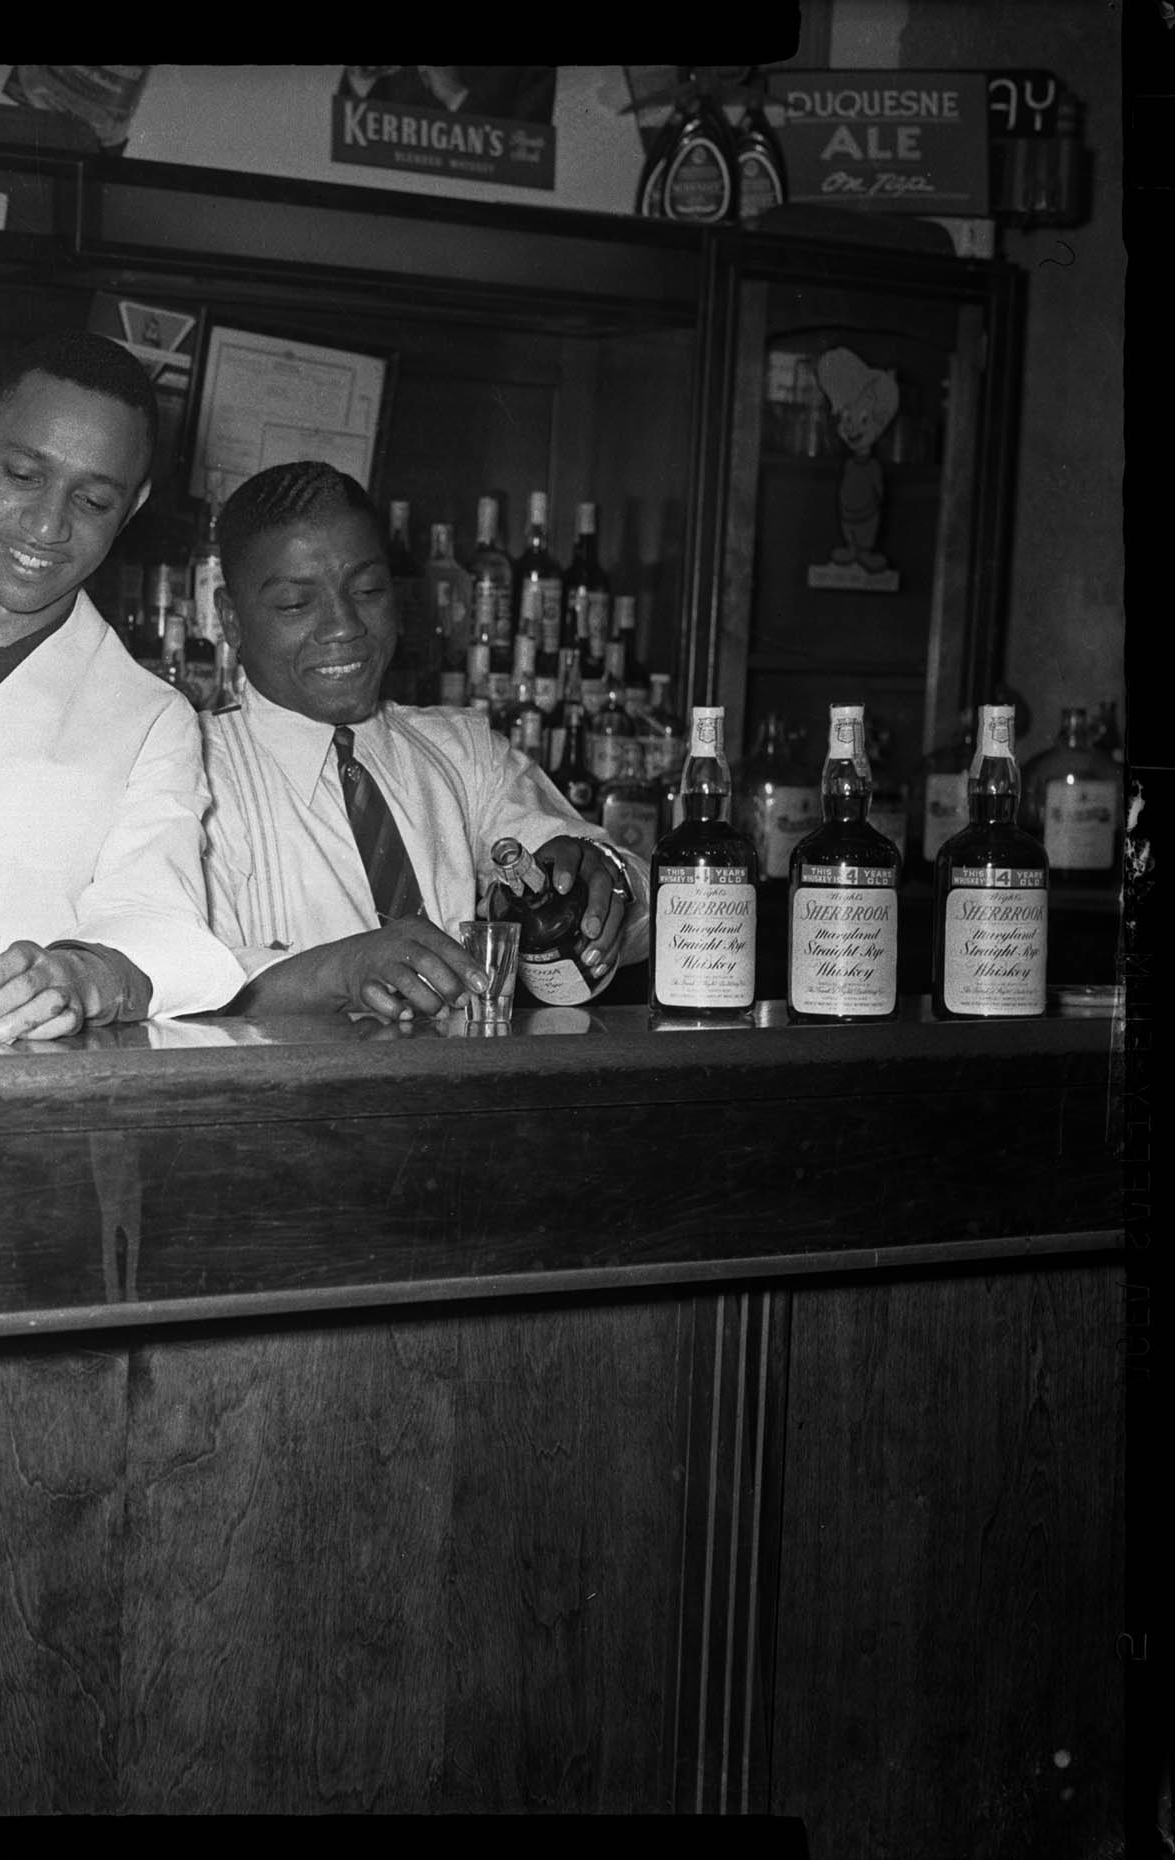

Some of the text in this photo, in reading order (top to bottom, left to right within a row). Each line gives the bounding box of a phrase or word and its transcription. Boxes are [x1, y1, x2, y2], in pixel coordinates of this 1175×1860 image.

[787, 90, 960, 119] DUQUESNE
[344, 100, 505, 157] KERRIGAN'S
[820, 125, 923, 161] ALE
[667, 868, 685, 876] THIS
[715, 869, 745, 877] YEARS
[811, 867, 831, 876] THIS
[845, 868, 856, 884] 4
[863, 869, 892, 878] YEARS
[963, 869, 984, 877] THIS
[996, 870, 1010, 886] 4
[1016, 870, 1043, 879] YEARS
[867, 877, 888, 885] OLD
[1020, 878, 1040, 886] OLD
[665, 896, 749, 915] SHERBROOK
[800, 899, 889, 921] SHERBROOK
[955, 899, 1044, 921] SHERBROOK
[679, 921, 743, 936] Maryland
[814, 927, 881, 942] Maryland
[971, 927, 1038, 942] Maryland
[668, 935, 746, 953] Straight Rye
[803, 940, 885, 960] Straight Rye
[960, 940, 1040, 960] Straight Rye
[680, 954, 737, 974] Whiskey
[815, 961, 874, 982] Whiskey
[973, 962, 1031, 982] Whiskey
